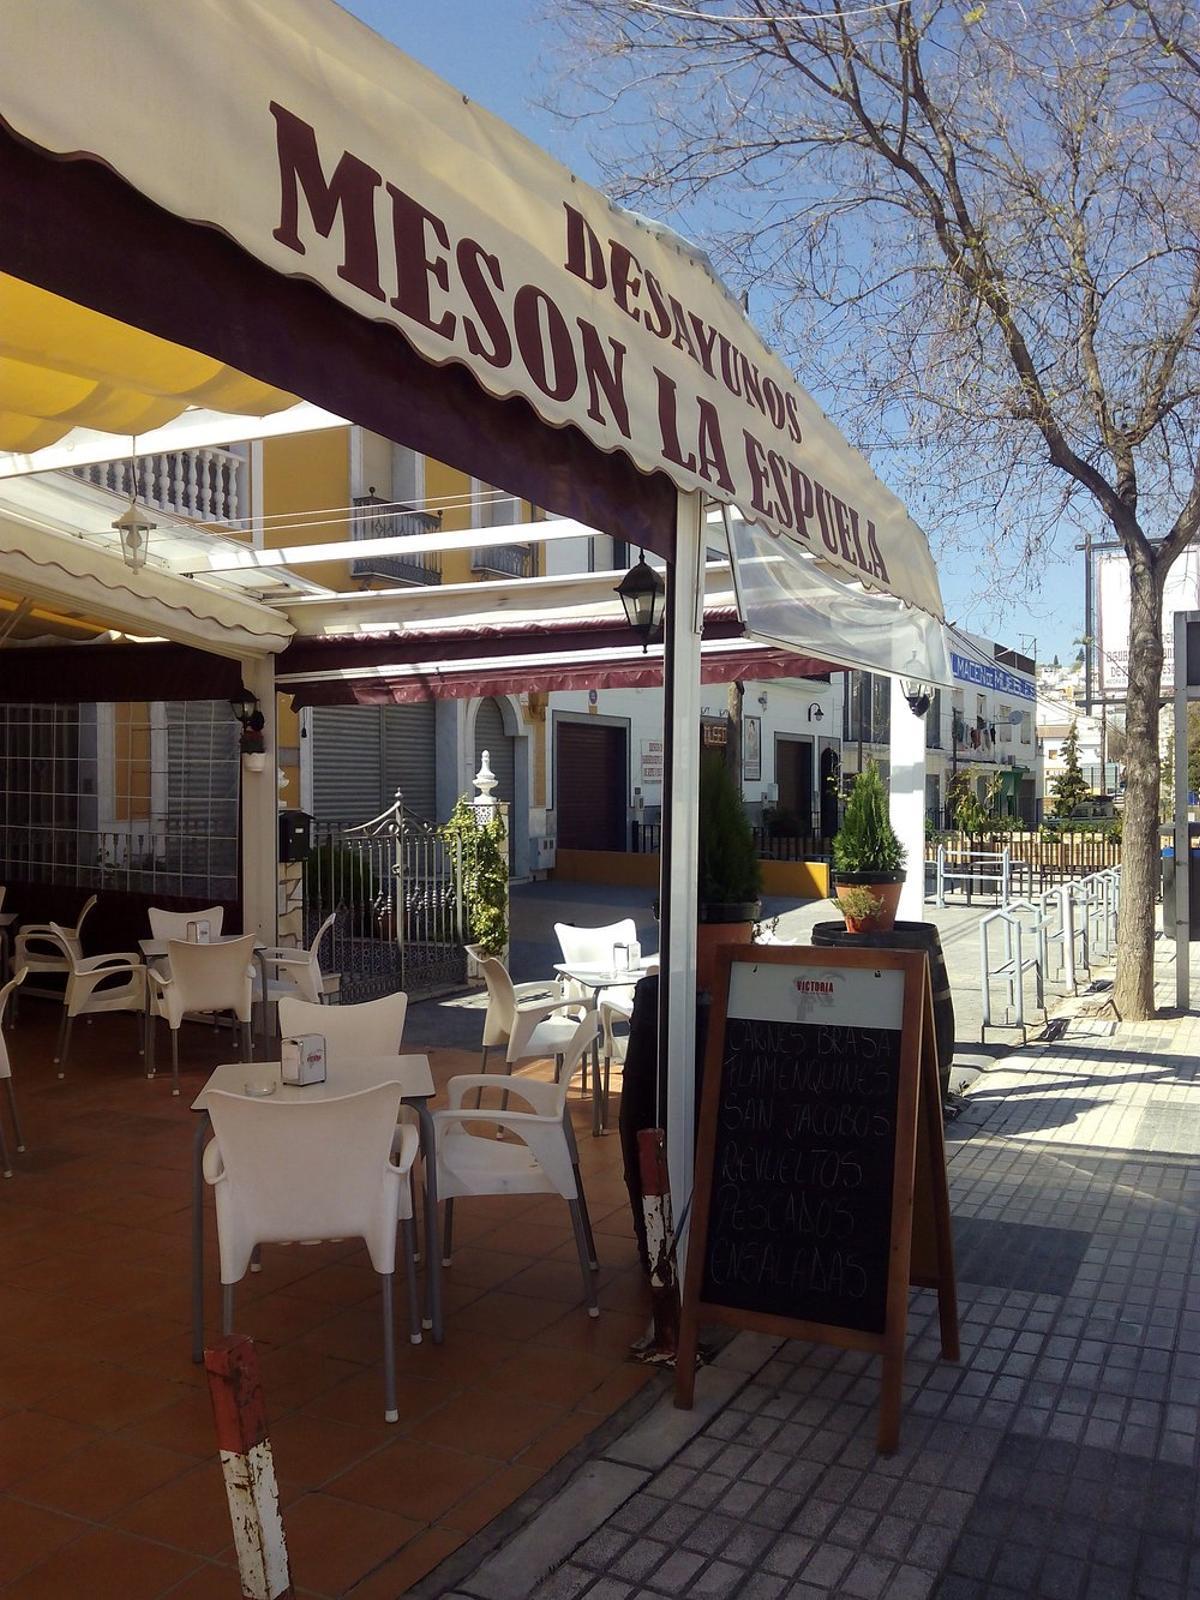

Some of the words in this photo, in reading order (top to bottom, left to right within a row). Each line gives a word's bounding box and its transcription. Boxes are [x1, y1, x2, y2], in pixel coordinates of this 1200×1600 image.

[270, 100, 632, 440] MESON
[653, 366, 736, 496] LA
[743, 428, 891, 585] ESPUELA
[563, 201, 802, 444] DESAYUNOS
[796, 979, 834, 993] VICTORIA
[727, 1021, 808, 1054] CARNES
[816, 1025, 891, 1058] BRASA
[723, 1093, 774, 1130] SAN
[786, 1103, 890, 1140] JACOBOS
[722, 1140, 864, 1189] REVUELTOS
[718, 1184, 855, 1239] PESCADOS
[711, 1240, 868, 1298] ENSALADAS
